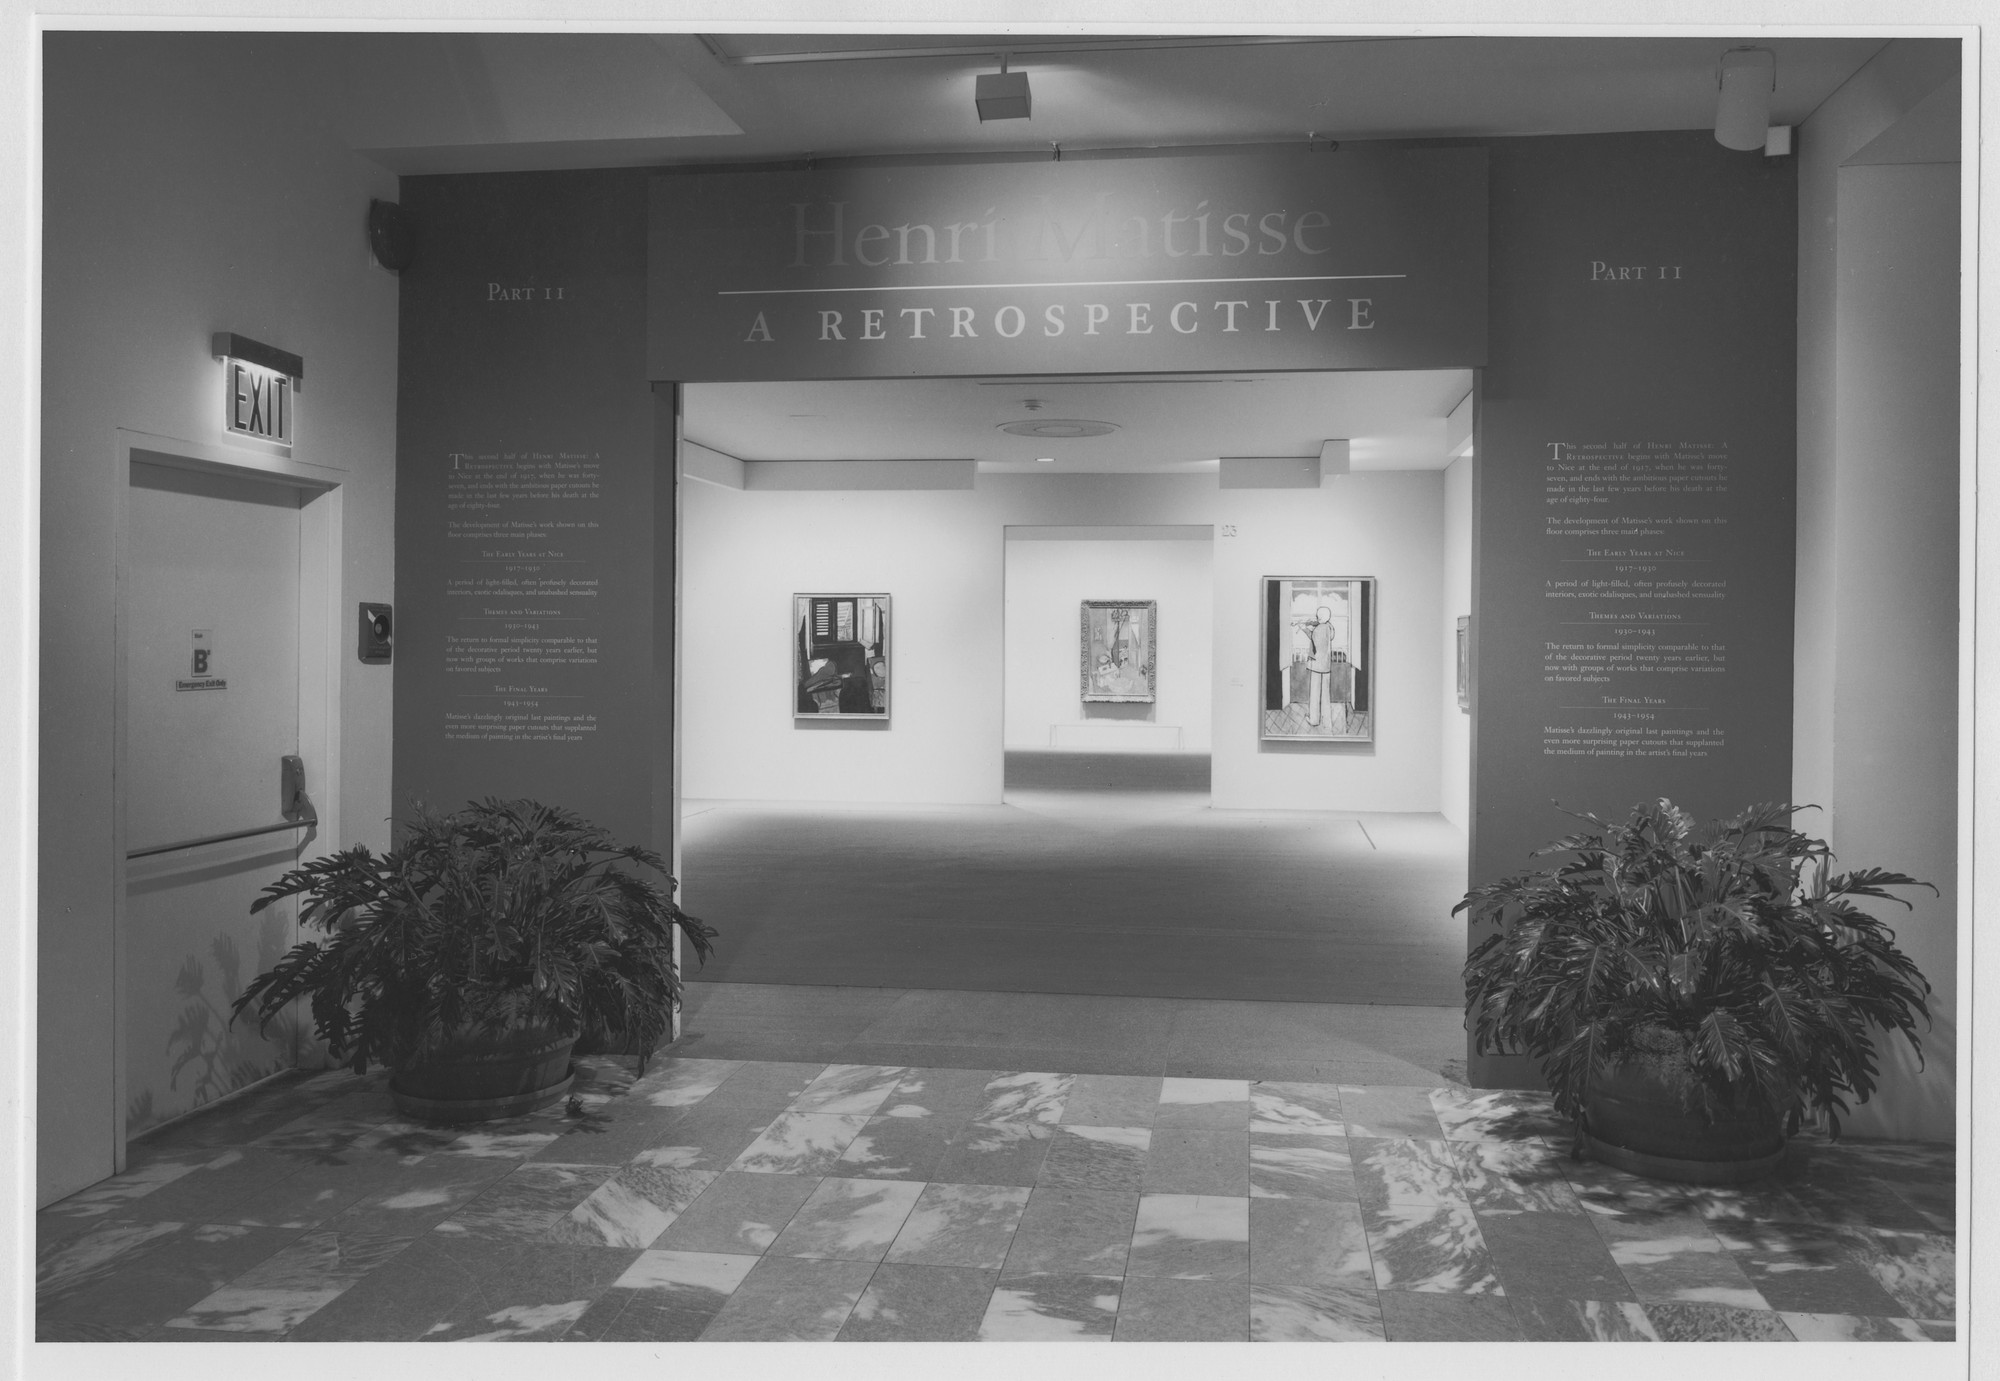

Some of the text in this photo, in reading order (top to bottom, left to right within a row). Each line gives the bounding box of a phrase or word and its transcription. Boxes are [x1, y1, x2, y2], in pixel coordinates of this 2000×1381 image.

[787, 195, 1333, 268] Henri Matisse
[1658, 266, 1682, 280] II
[544, 287, 564, 300] II
[745, 297, 1377, 342] A RETROSPECTIVE
[234, 364, 287, 439] EXIT
[1569, 496, 1609, 506] eighty-four.
[1564, 517, 1608, 526] development
[1564, 528, 1599, 537] comprises
[1640, 528, 1665, 537] phases:
[1555, 579, 1577, 589] period
[1592, 580, 1630, 589] light-filled,
[1656, 580, 1687, 589] profusely
[1545, 590, 1576, 599] interiors,
[1600, 591, 1637, 600] odalisques,
[1692, 591, 1725, 601] sensuality
[1622, 643, 1655, 652] simplicity
[1658, 643, 1698, 653] comparable
[1610, 653, 1632, 663] period
[1636, 654, 1659, 663] twenty
[1685, 654, 1709, 662] earlier,
[1656, 664, 1688, 674] comprise
[1583, 675, 1610, 684] subjects
[1577, 726, 1612, 736] dazzlingly
[1615, 727, 1642, 736] original
[1661, 727, 1693, 737] paintings
[1582, 738, 1617, 747] surprising
[1686, 739, 1724, 748] supplanted
[1596, 748, 1625, 758] painting
